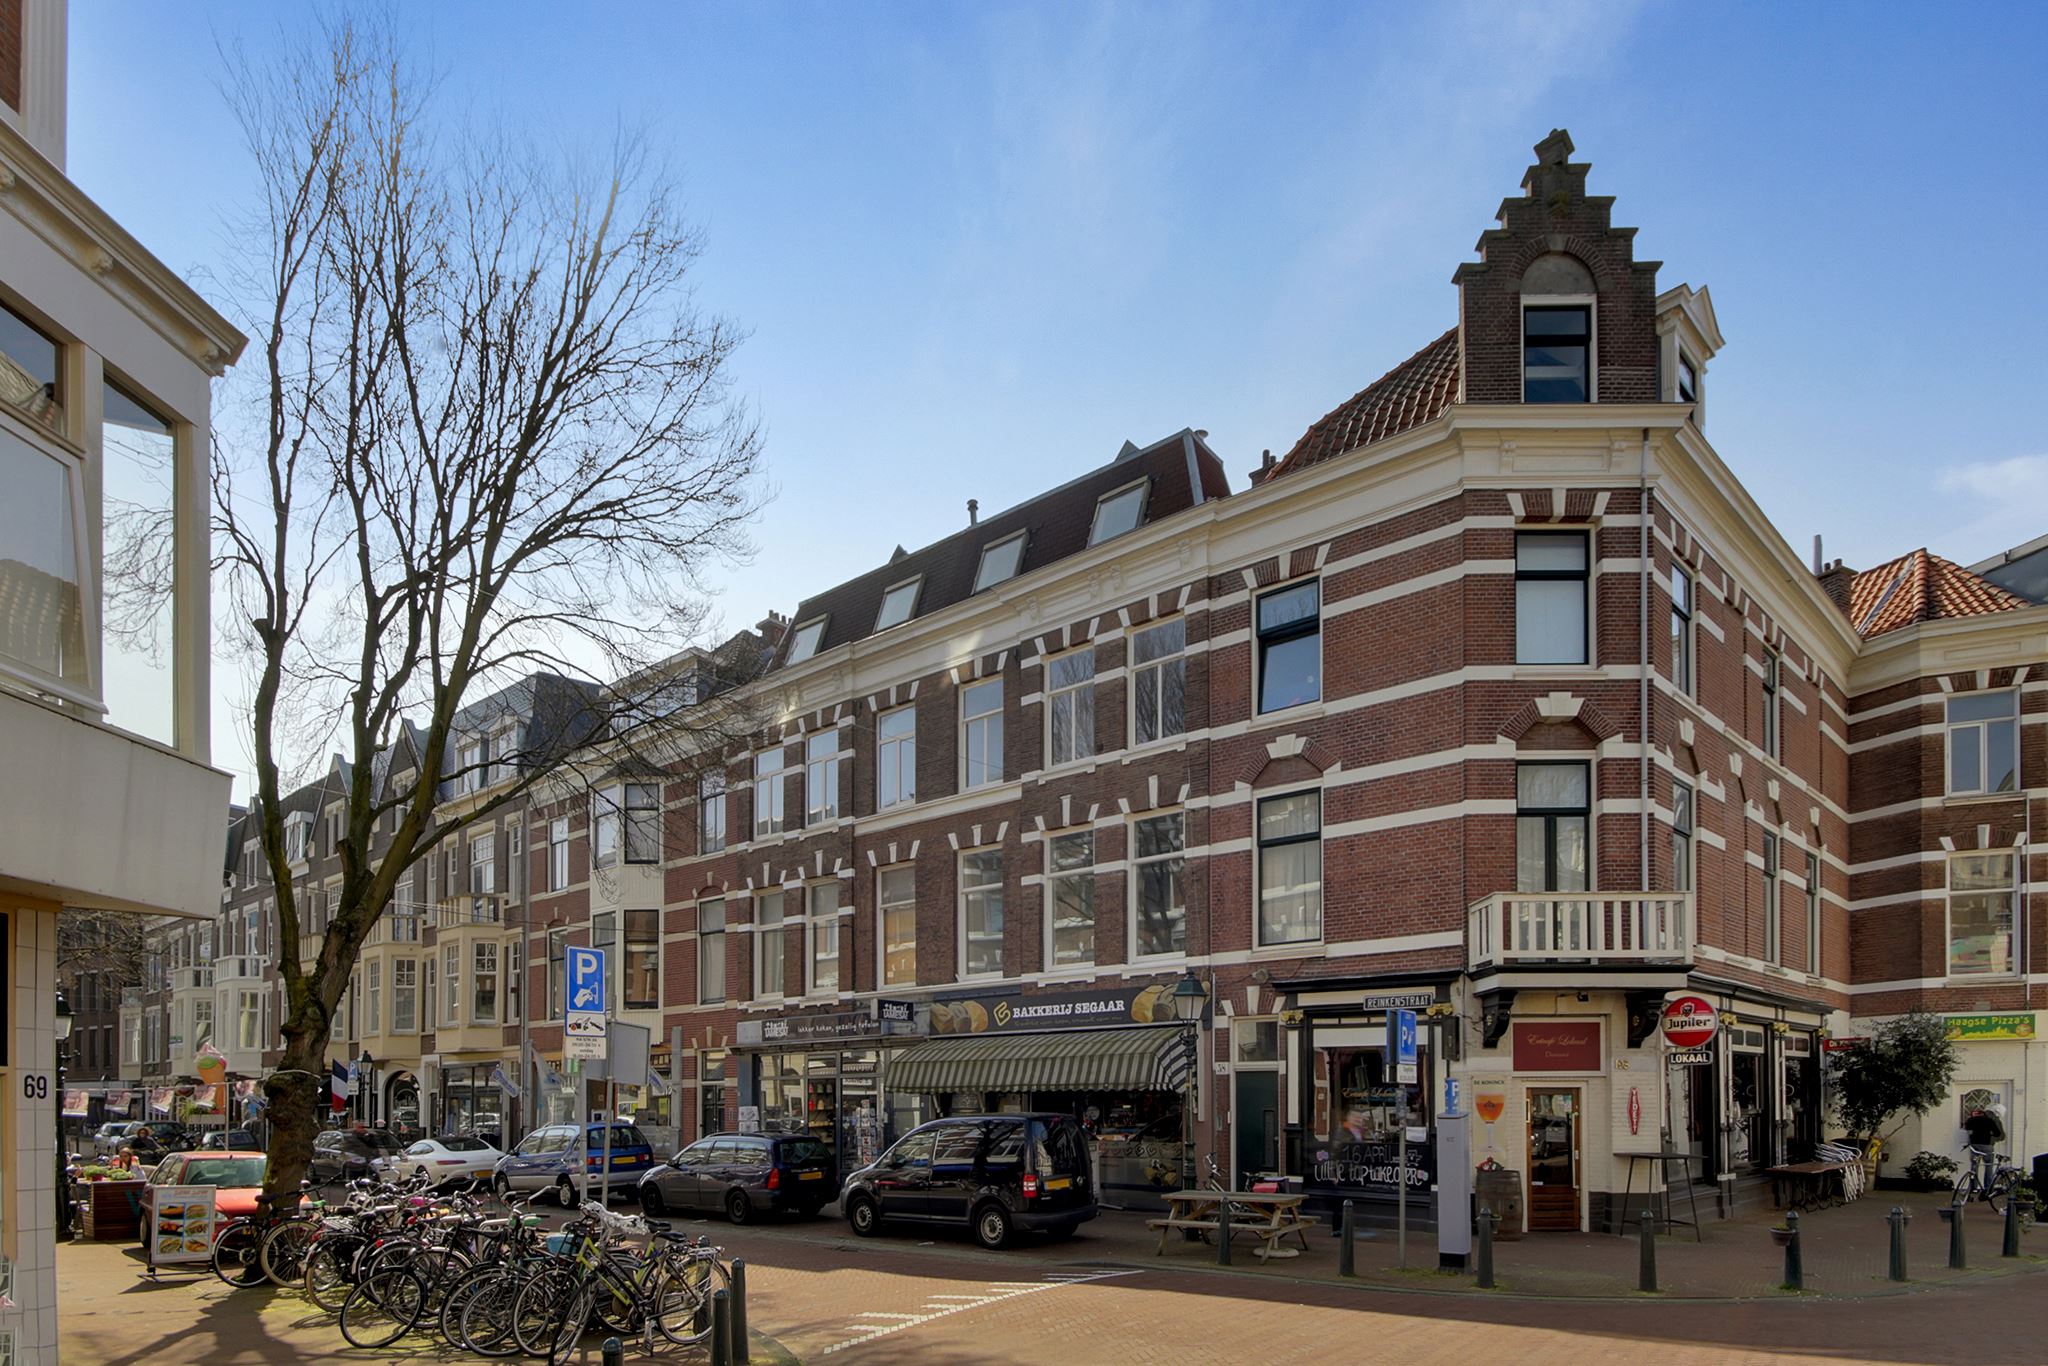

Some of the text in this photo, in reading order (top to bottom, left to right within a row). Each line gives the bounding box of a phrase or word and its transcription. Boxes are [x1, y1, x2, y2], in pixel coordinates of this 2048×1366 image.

[577, 953, 598, 985] P
[1367, 996, 1429, 1008] REINKENSTRAAT
[1013, 1000, 1125, 1018] BAKKERIJ SEGAAR
[1668, 1017, 1711, 1029] Jupiler
[1947, 1016, 2030, 1027] Haagse Pizza's
[1670, 1053, 1709, 1063] LOKAAL
[24, 1075, 47, 1099] 69
